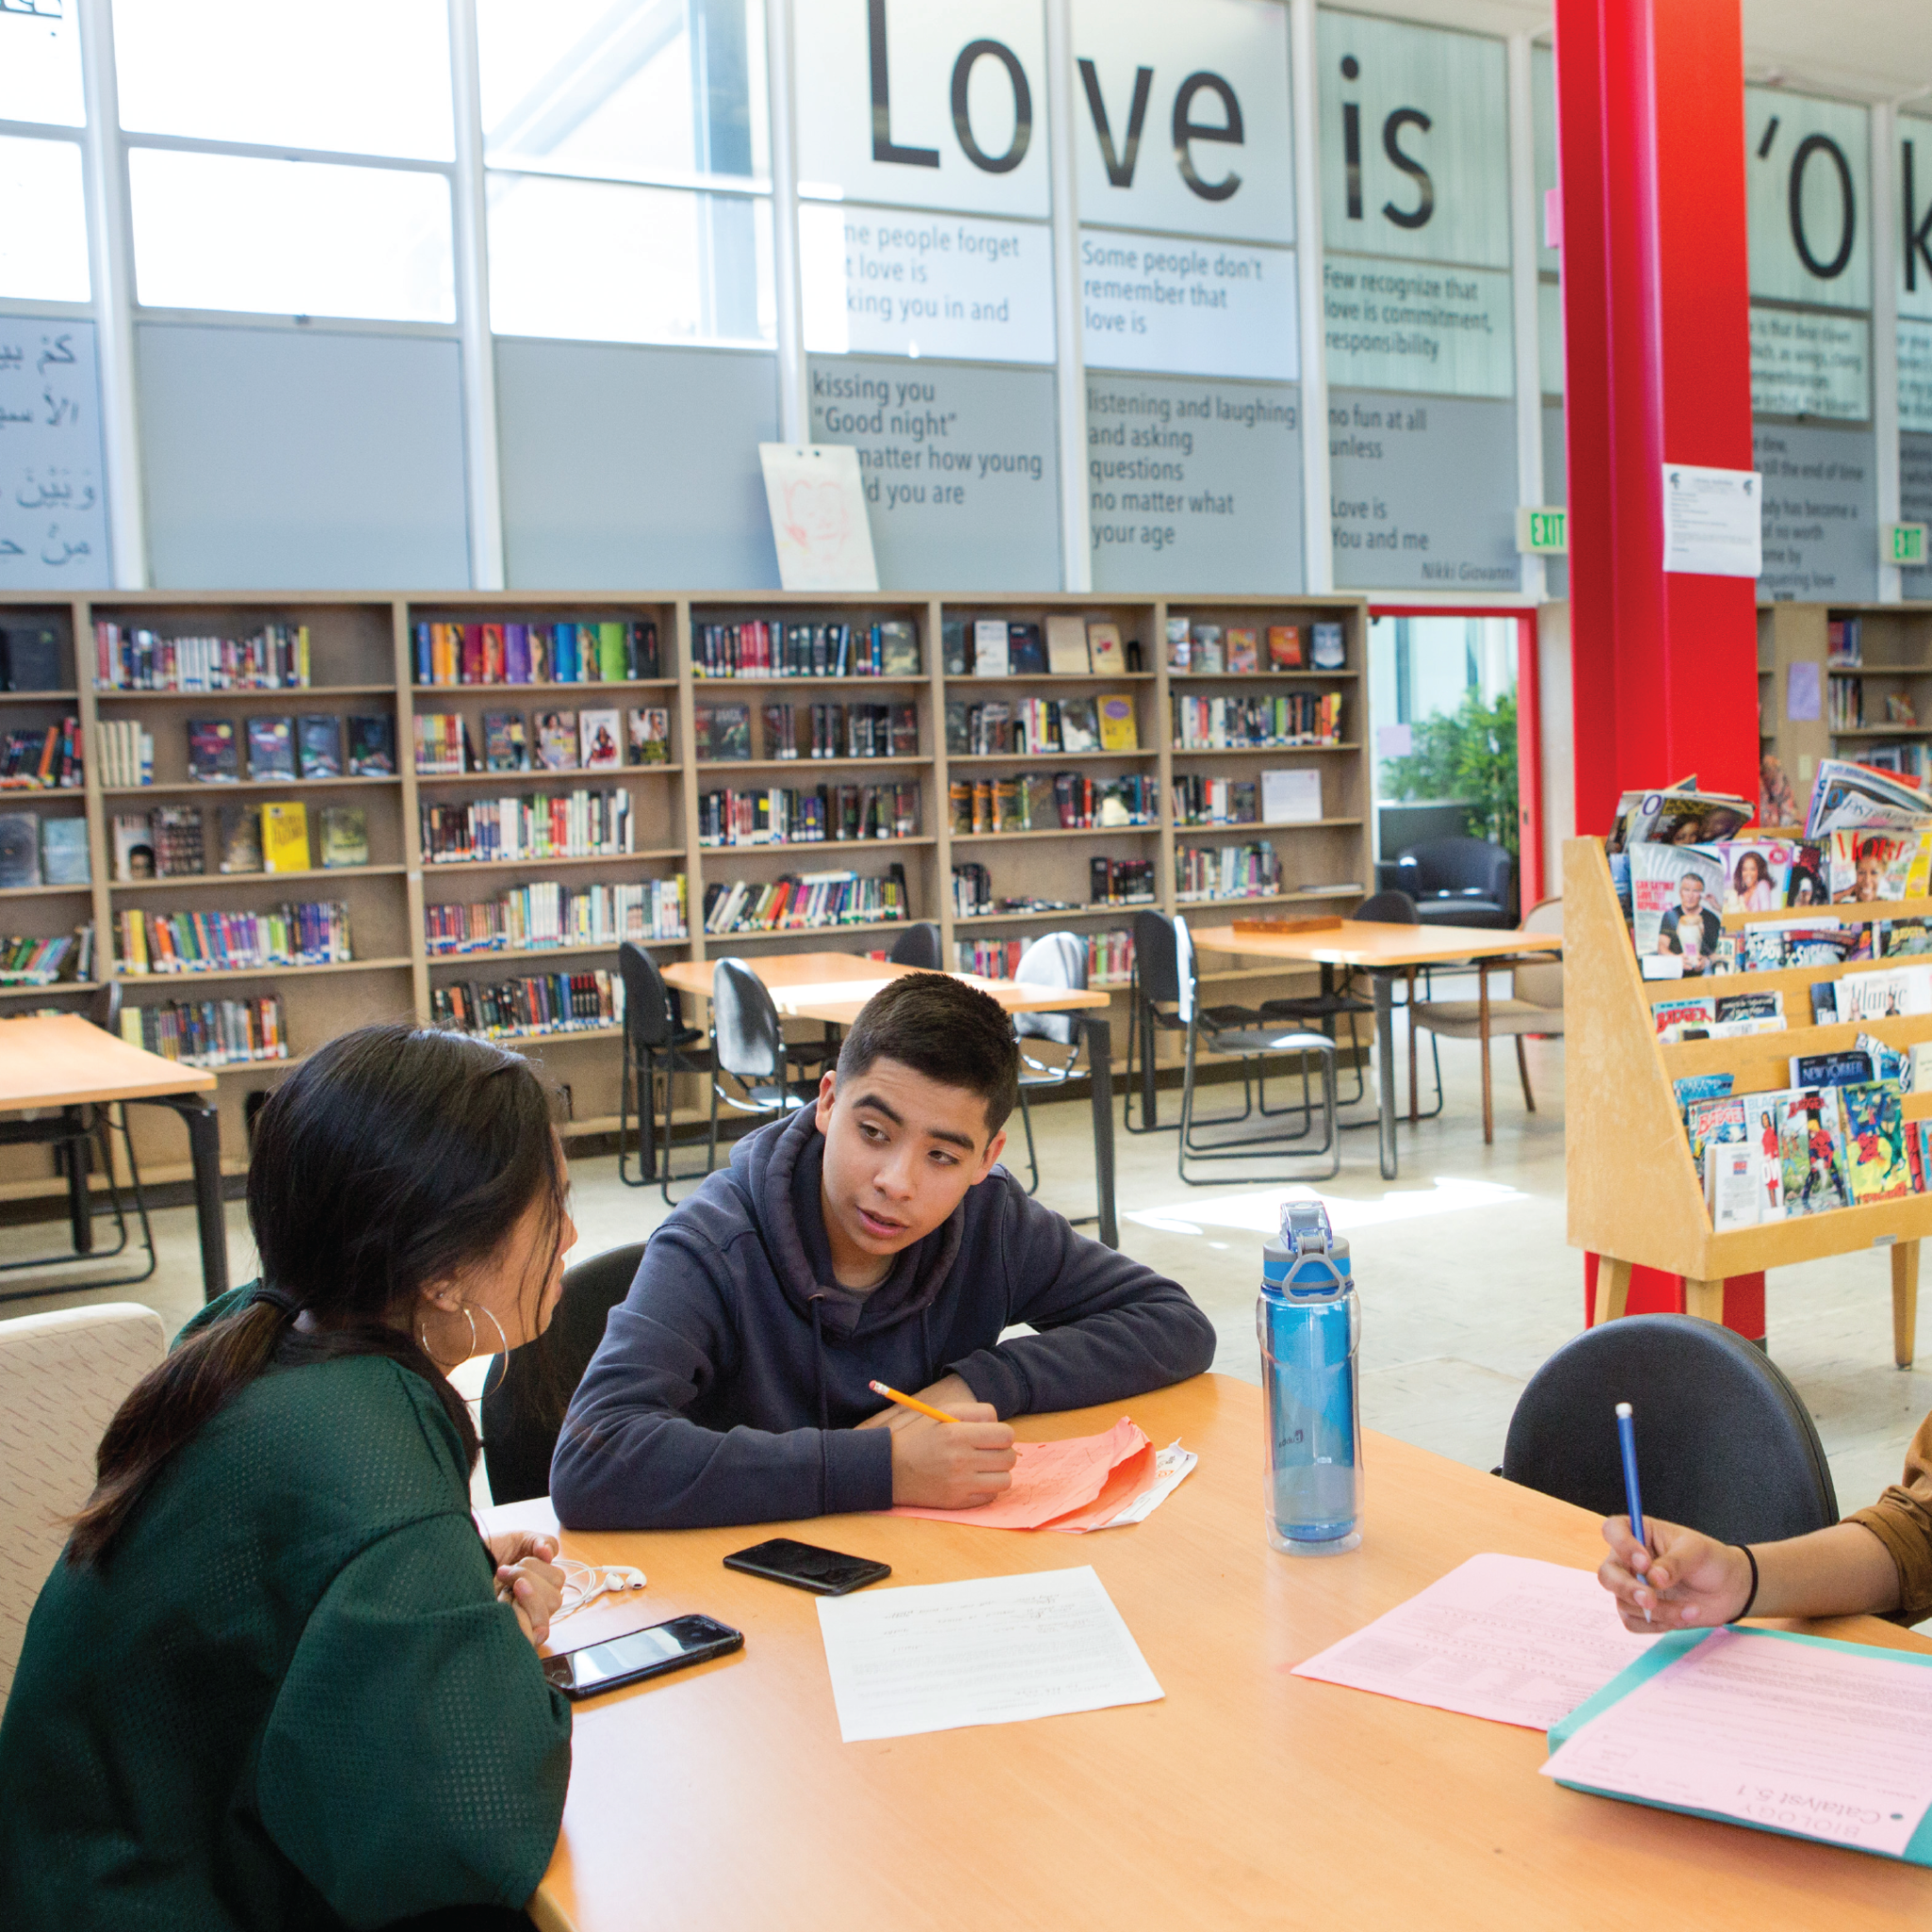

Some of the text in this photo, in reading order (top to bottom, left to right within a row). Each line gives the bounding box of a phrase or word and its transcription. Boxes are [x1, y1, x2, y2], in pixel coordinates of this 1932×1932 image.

[868, 0, 1436, 230] Love is
[877, 225, 952, 256] people
[958, 226, 1020, 262] forget
[859, 252, 904, 281] love
[910, 258, 928, 284] is
[1081, 241, 1263, 281] Some people don't
[1085, 279, 1228, 309] remember that
[1324, 264, 1479, 302] Few recognize that
[898, 296, 938, 323] you
[944, 294, 964, 319] in
[971, 296, 1009, 323] and
[1085, 307, 1148, 334] love is
[1324, 294, 1494, 335] love is commitment,
[1325, 330, 1441, 363] responsibility
[813, 370, 936, 408] kissing you
[814, 406, 958, 443] "Good night"
[1087, 387, 1297, 431] listening and laughing
[1328, 402, 1427, 431] no fun at all
[1089, 422, 1194, 457] and asking
[1328, 433, 1384, 459] unless
[858, 442, 1043, 481] matter how young
[1089, 456, 1185, 485] questions
[886, 482, 926, 510] you
[931, 484, 965, 505] are
[1091, 489, 1235, 515] no matter what
[1330, 496, 1388, 520] Love is
[1091, 524, 1175, 552] your age
[1332, 525, 1430, 551] You and me
[1530, 512, 1565, 546] EXIT
[1893, 526, 1922, 559] EXIT
[1641, 794, 1663, 817] O
[1736, 1784, 1774, 1802] 5.1
[1779, 1791, 1881, 1825] Catalyst
[1740, 1804, 1860, 1838] BIOLOGY
